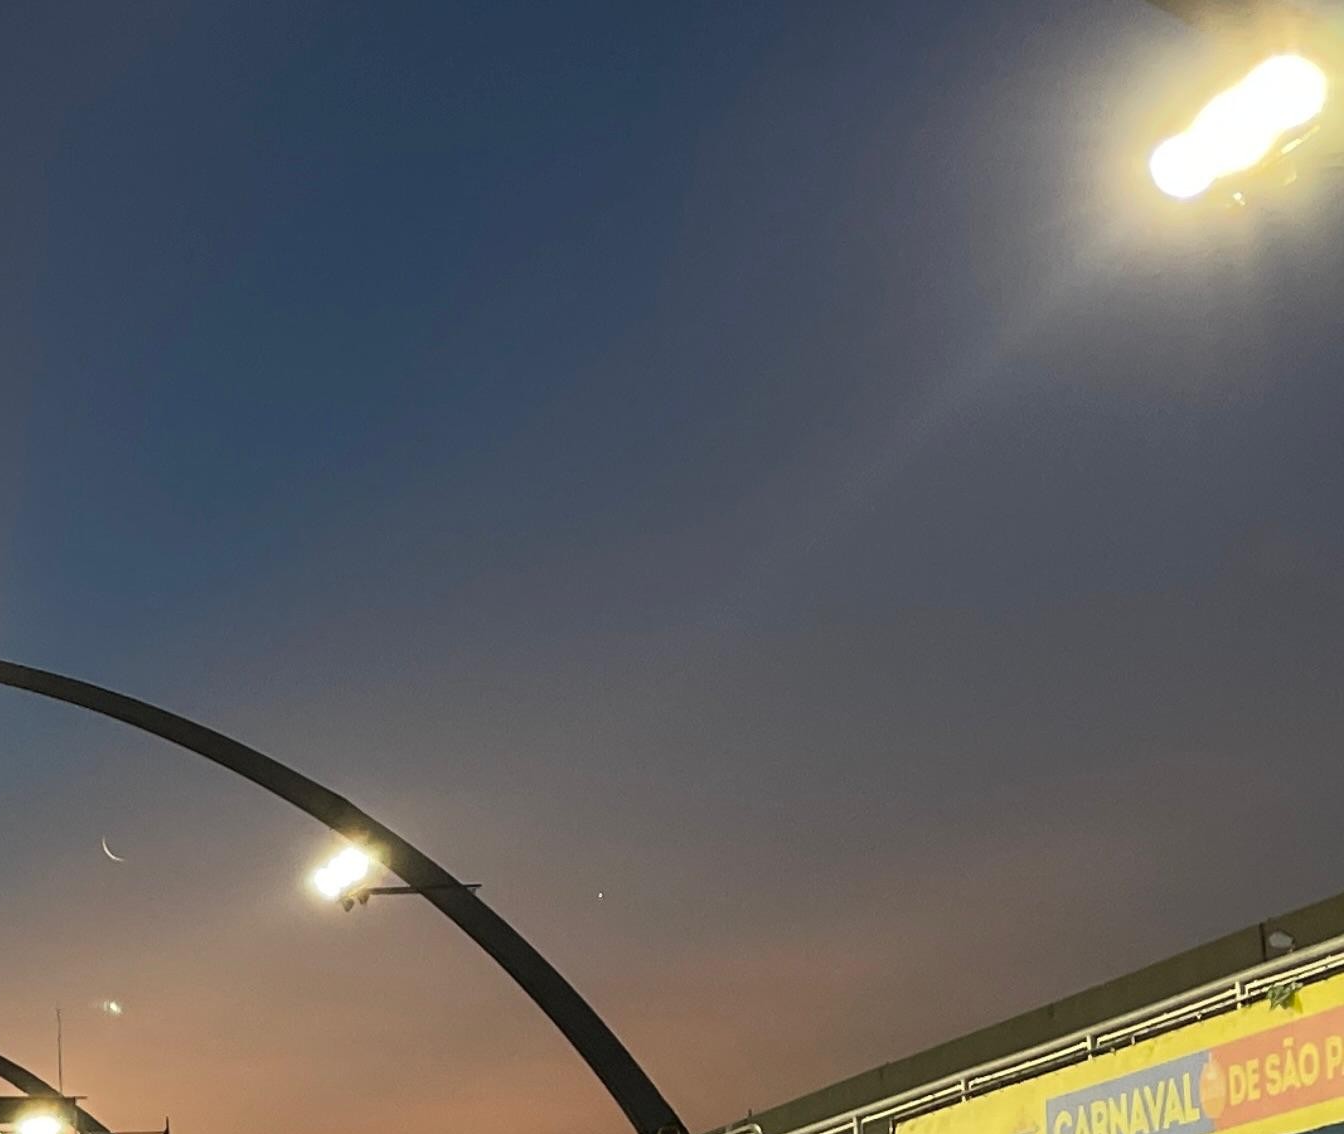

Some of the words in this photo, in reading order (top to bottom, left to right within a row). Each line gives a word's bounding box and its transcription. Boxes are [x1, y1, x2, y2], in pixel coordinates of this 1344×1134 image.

[1228, 1056, 1261, 1106] DE
[1265, 1036, 1320, 1097] SÃO
[1325, 1034, 1344, 1080] P
